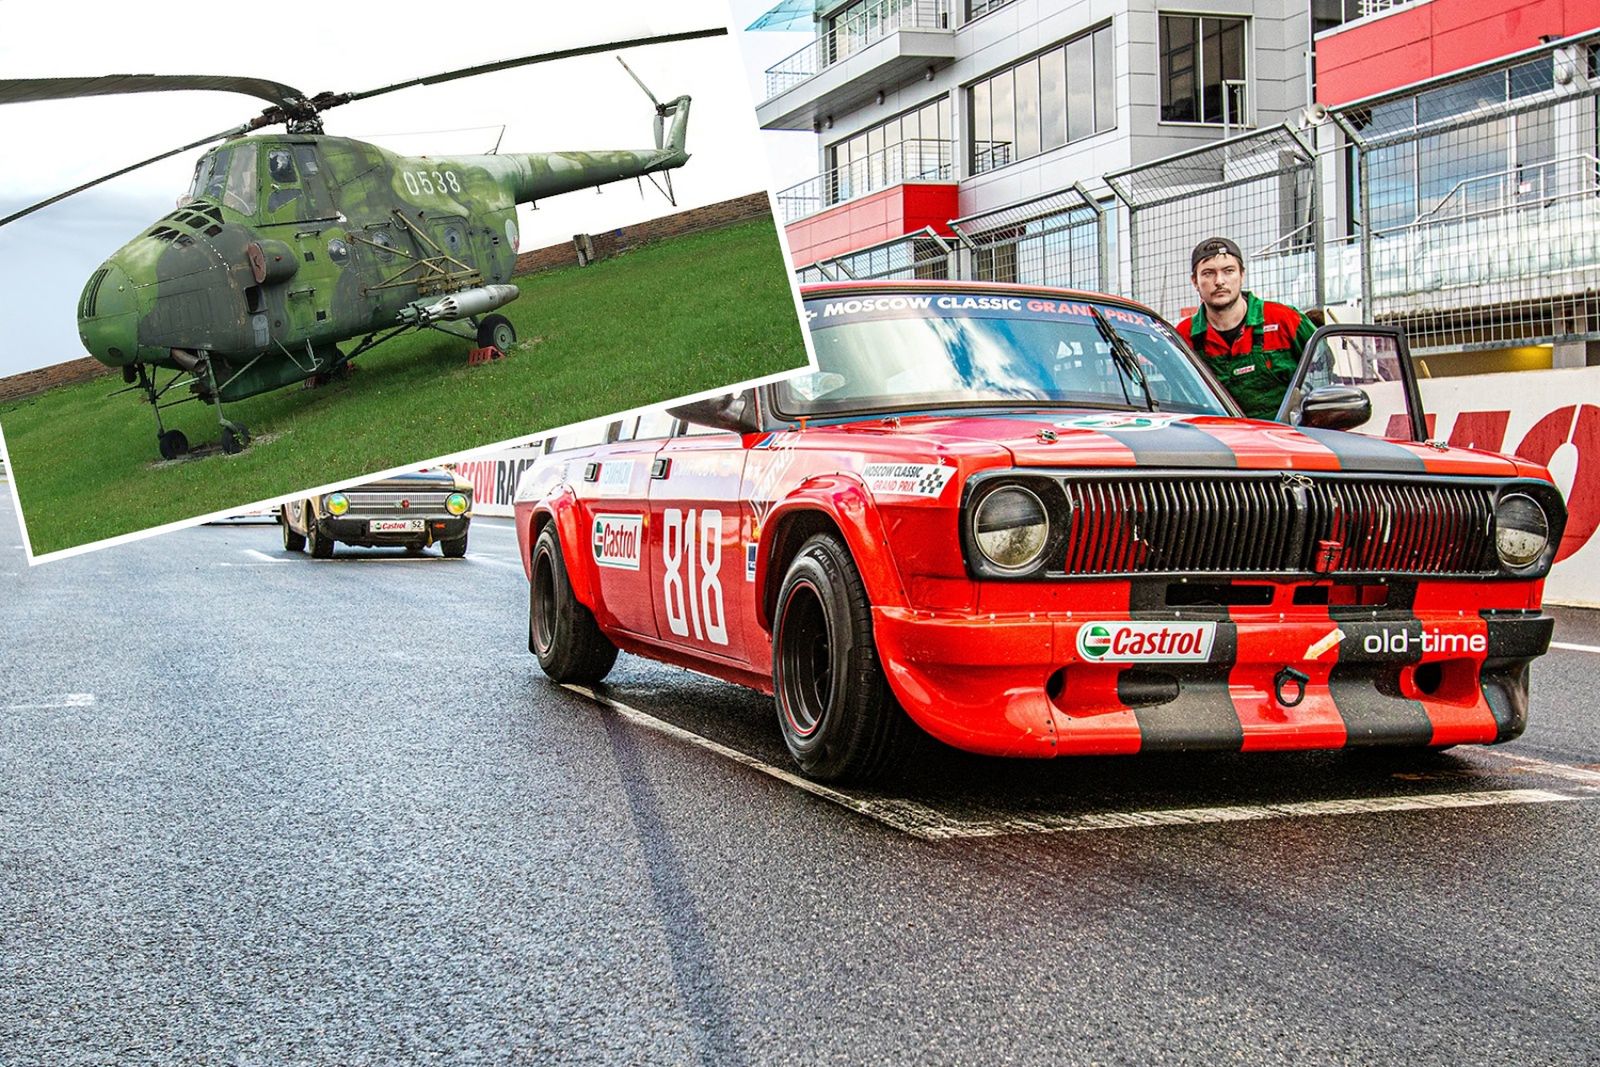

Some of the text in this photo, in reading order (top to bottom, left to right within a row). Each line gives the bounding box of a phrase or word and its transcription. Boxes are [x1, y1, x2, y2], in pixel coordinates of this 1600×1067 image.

[403, 170, 460, 195] 0538
[823, 297, 932, 317] MOSCOW
[937, 297, 1022, 311] CLASSIC
[1103, 308, 1145, 326] PRIX
[863, 465, 924, 478] MOSCOW CLASSIC
[898, 480, 917, 492] PRIX
[382, 522, 407, 530] Castrol
[603, 522, 638, 559] Castrol
[663, 508, 729, 646] 818
[1112, 626, 1204, 655] Castrol
[1363, 627, 1487, 653] old-time
